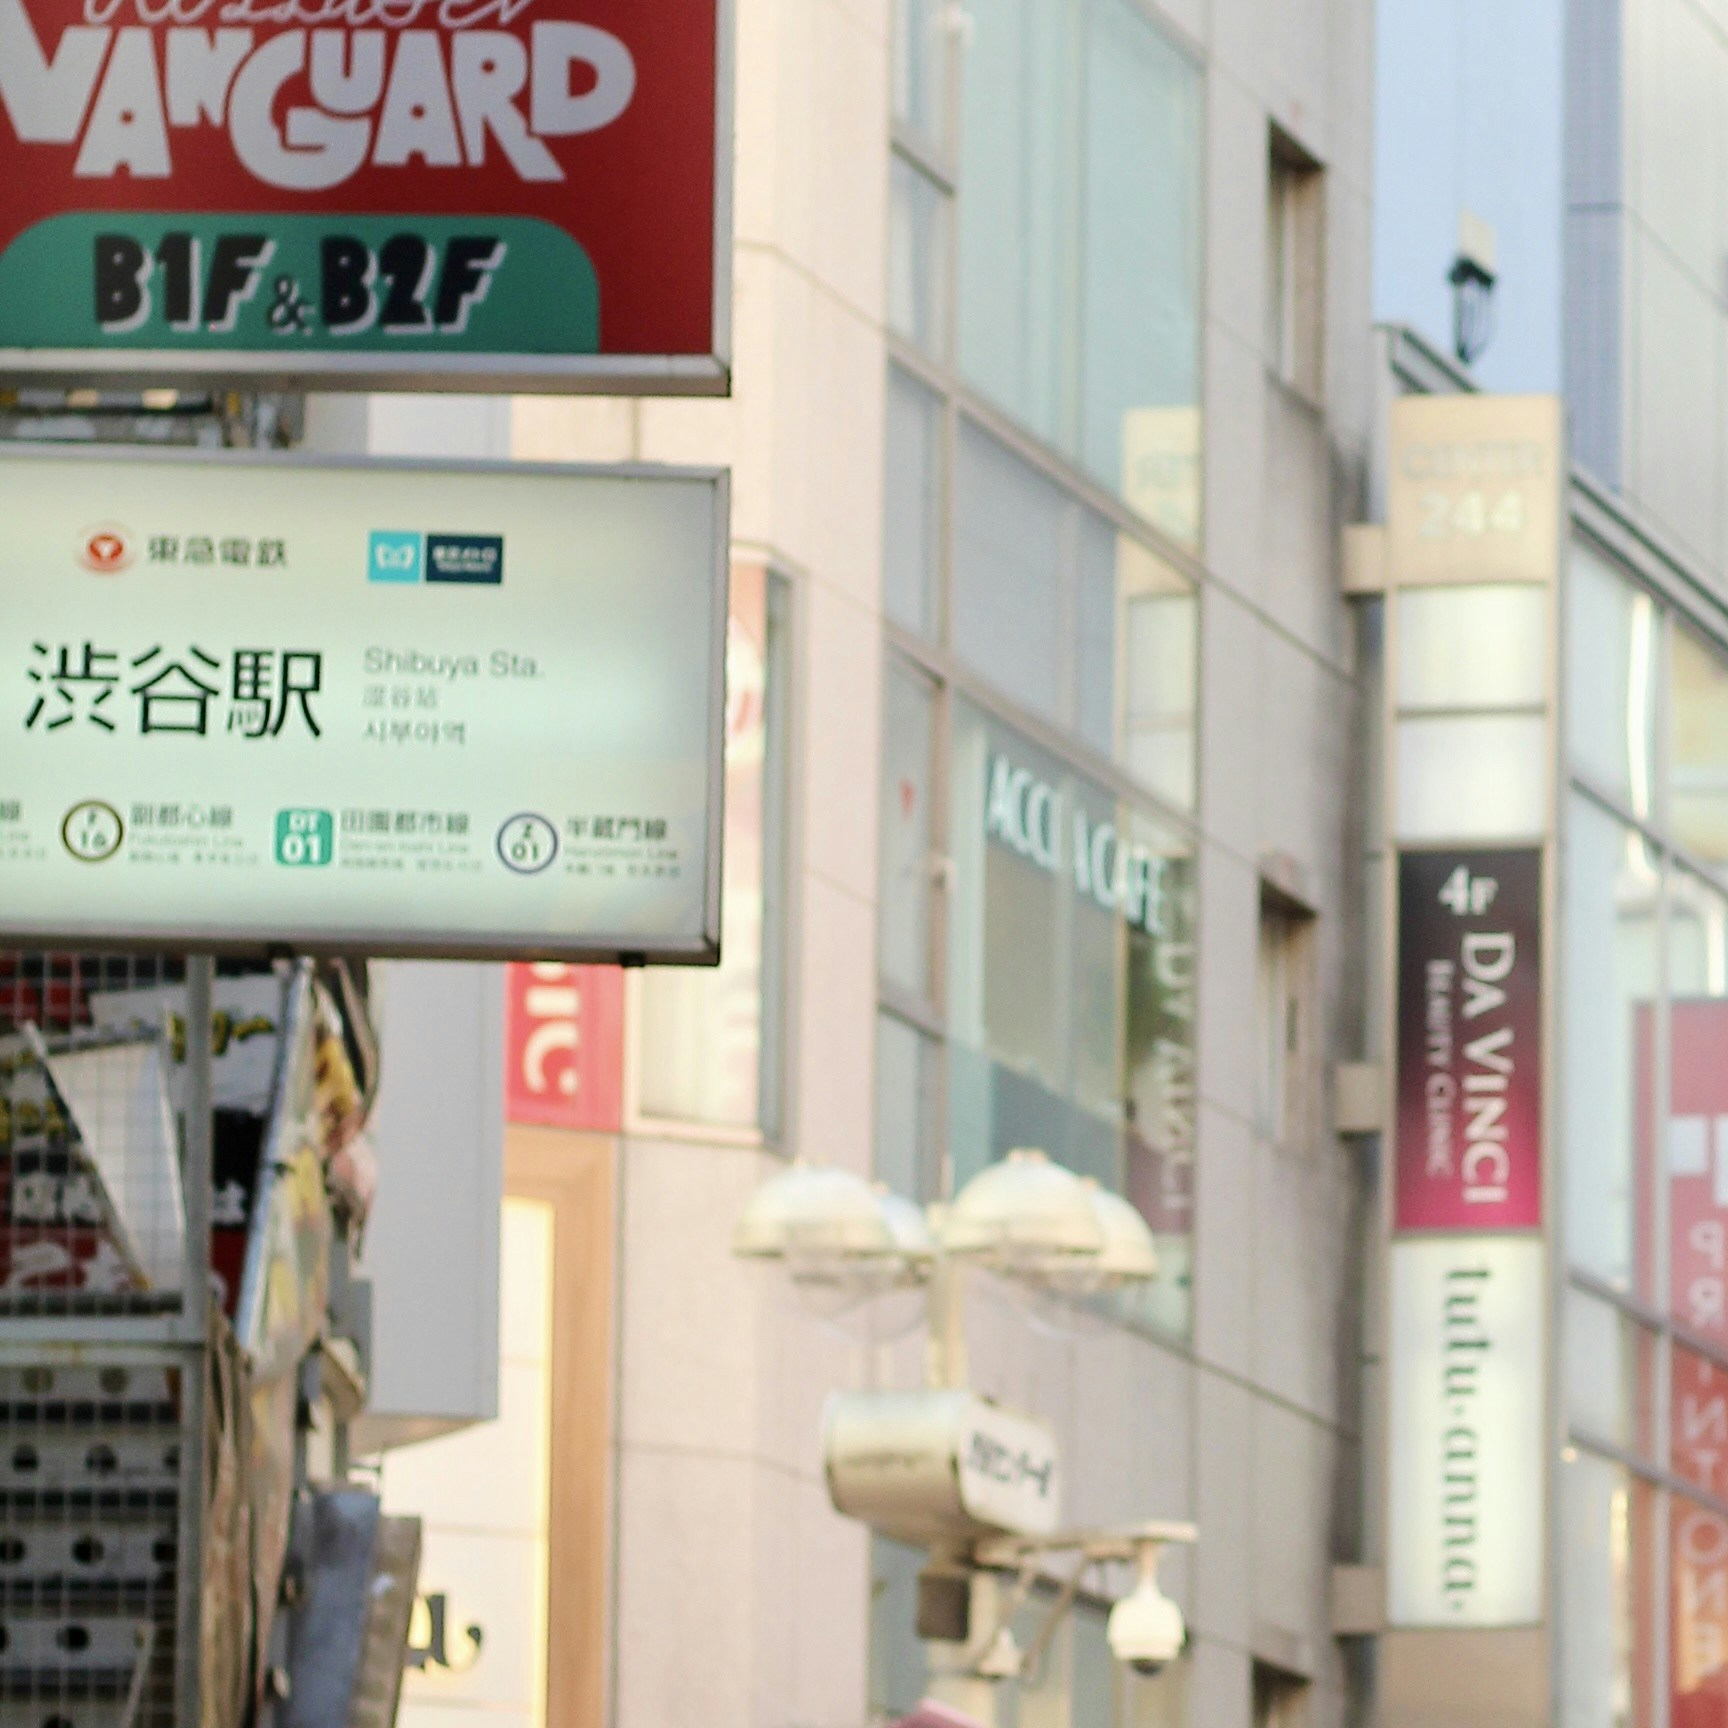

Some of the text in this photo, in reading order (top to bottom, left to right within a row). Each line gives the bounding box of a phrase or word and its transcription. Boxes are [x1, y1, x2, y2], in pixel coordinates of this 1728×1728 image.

[94, 232, 275, 332] B1F
[320, 235, 507, 335] B2F
[23, 640, 324, 739] 渋谷駅
[363, 647, 546, 682] Shibuya Sta.
[281, 834, 322, 863] 01
[1461, 931, 1516, 1205] DA VINCI
